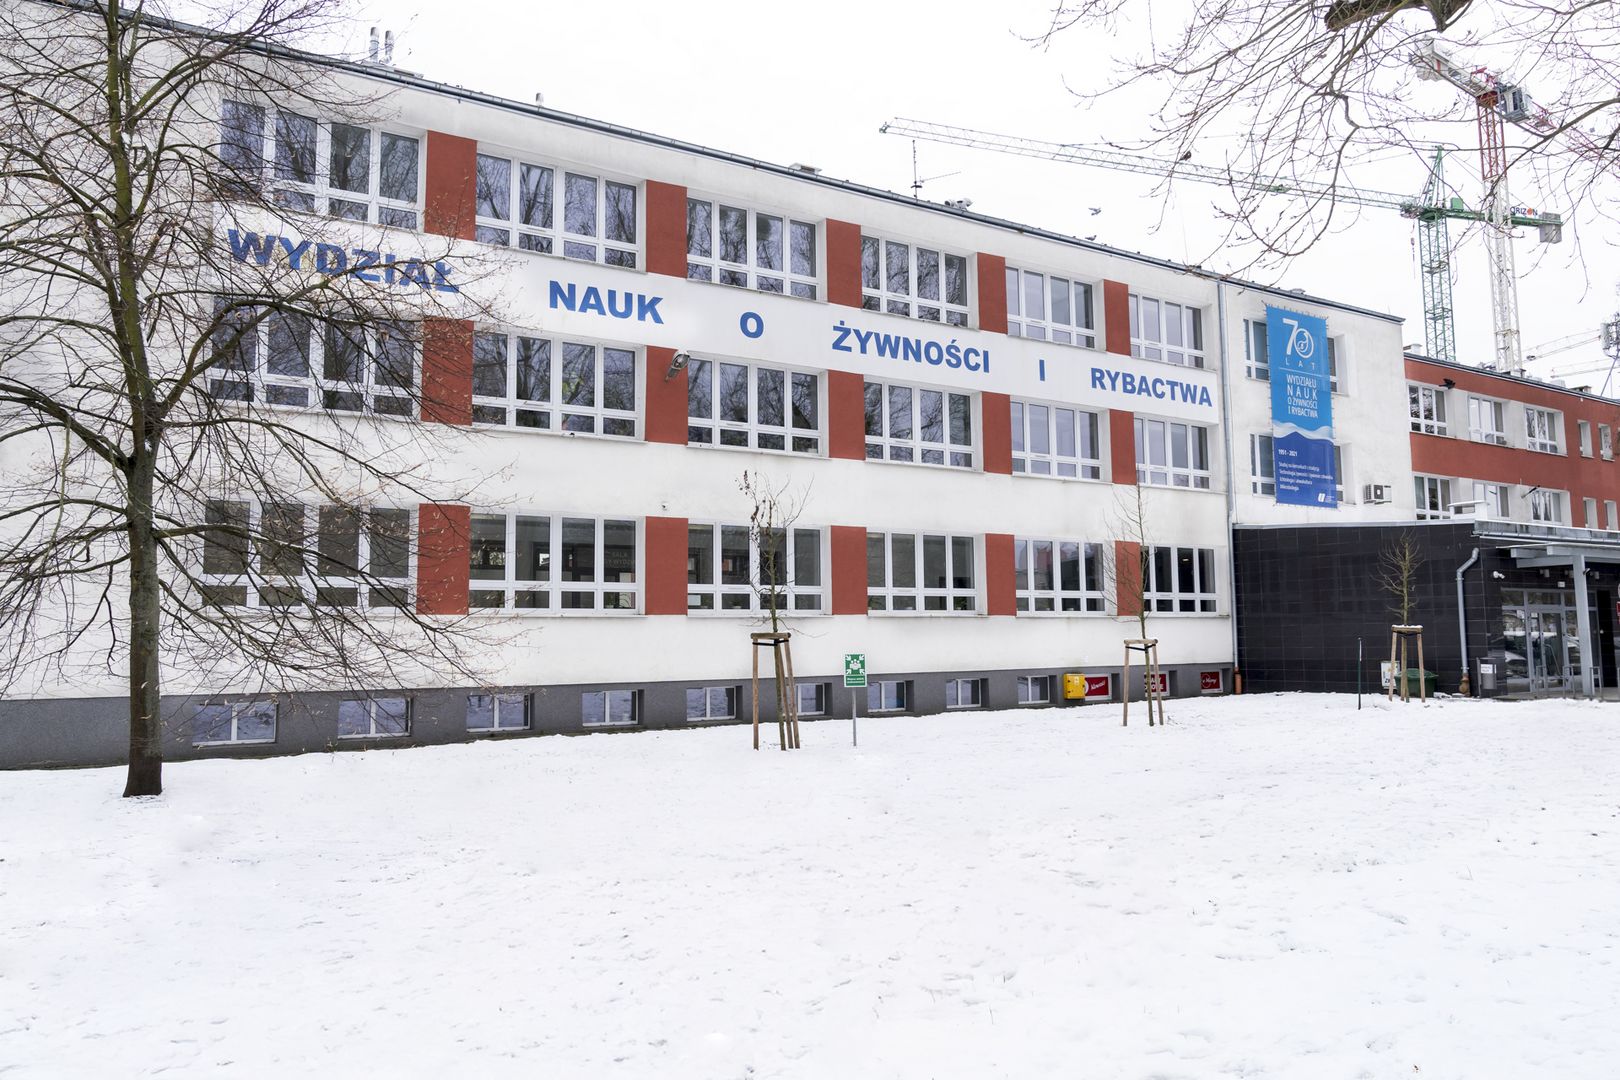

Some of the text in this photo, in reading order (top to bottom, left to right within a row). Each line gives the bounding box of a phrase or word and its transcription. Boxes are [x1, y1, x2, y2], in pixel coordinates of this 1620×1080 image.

[227, 228, 1213, 408] WYDZIAŁ NAUK O ŻYWNOŚCI I RYBACTWA
[1282, 317, 1315, 359] 70
[1285, 356, 1316, 371] LAT
[1286, 373, 1318, 389] WYDZIAŁU
[1287, 383, 1318, 401] NAUK
[1292, 396, 1318, 410] ŻYWNOŚCI
[1291, 405, 1319, 419] RYBACTWA
